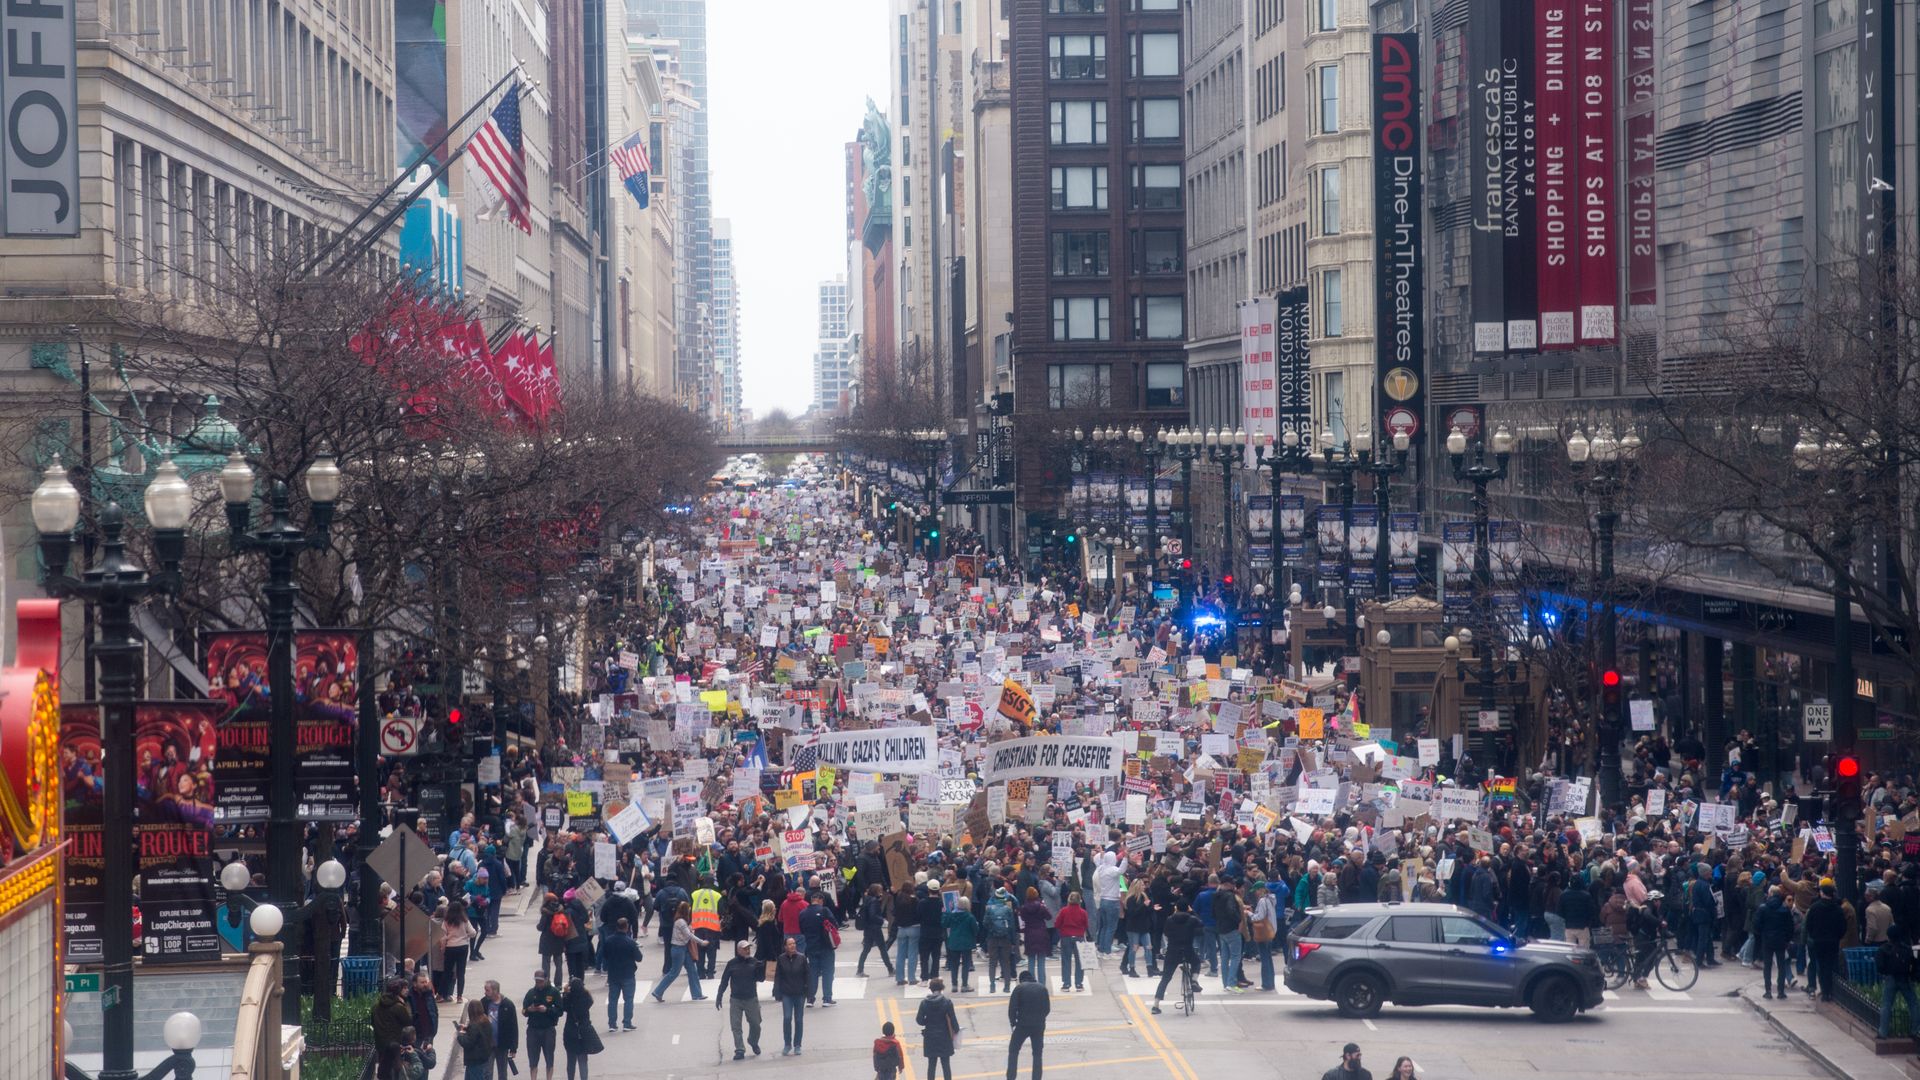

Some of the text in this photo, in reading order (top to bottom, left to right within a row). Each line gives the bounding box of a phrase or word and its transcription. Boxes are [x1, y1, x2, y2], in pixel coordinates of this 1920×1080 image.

[1545, 9, 1564, 91] DINING
[1382, 36, 1414, 151] amc
[1585, 0, 1606, 257] SHOPS AT 108 N ST
[1474, 68, 1501, 234] francesca's
[1504, 58, 1519, 237] BANANA REPUBLIC
[1524, 100, 1535, 196] FACTORY
[1546, 147, 1566, 266] SHOPPING
[1280, 306, 1294, 407] NORDSTROM
[1857, 678, 1874, 698] ZARA
[1002, 688, 1037, 718] ESIST
[1807, 706, 1829, 716] ONE
[1807, 717, 1830, 727] WAY
[297, 726, 351, 746] ROUGE!
[817, 742, 848, 764] KILLING
[852, 739, 880, 763] GAZA'S
[884, 737, 926, 761] CHILDREN
[993, 744, 1112, 772] CHRISTIANS FOR CEASEFIRE
[218, 794, 264, 803] LoopChicago.com
[303, 792, 348, 801] LoopChicago.com
[141, 831, 209, 857] ROUGE!
[786, 830, 805, 842] STOP
[818, 871, 835, 881] ANDS
[821, 882, 833, 891] FF!
[151, 920, 212, 931] LoopChicago.com
